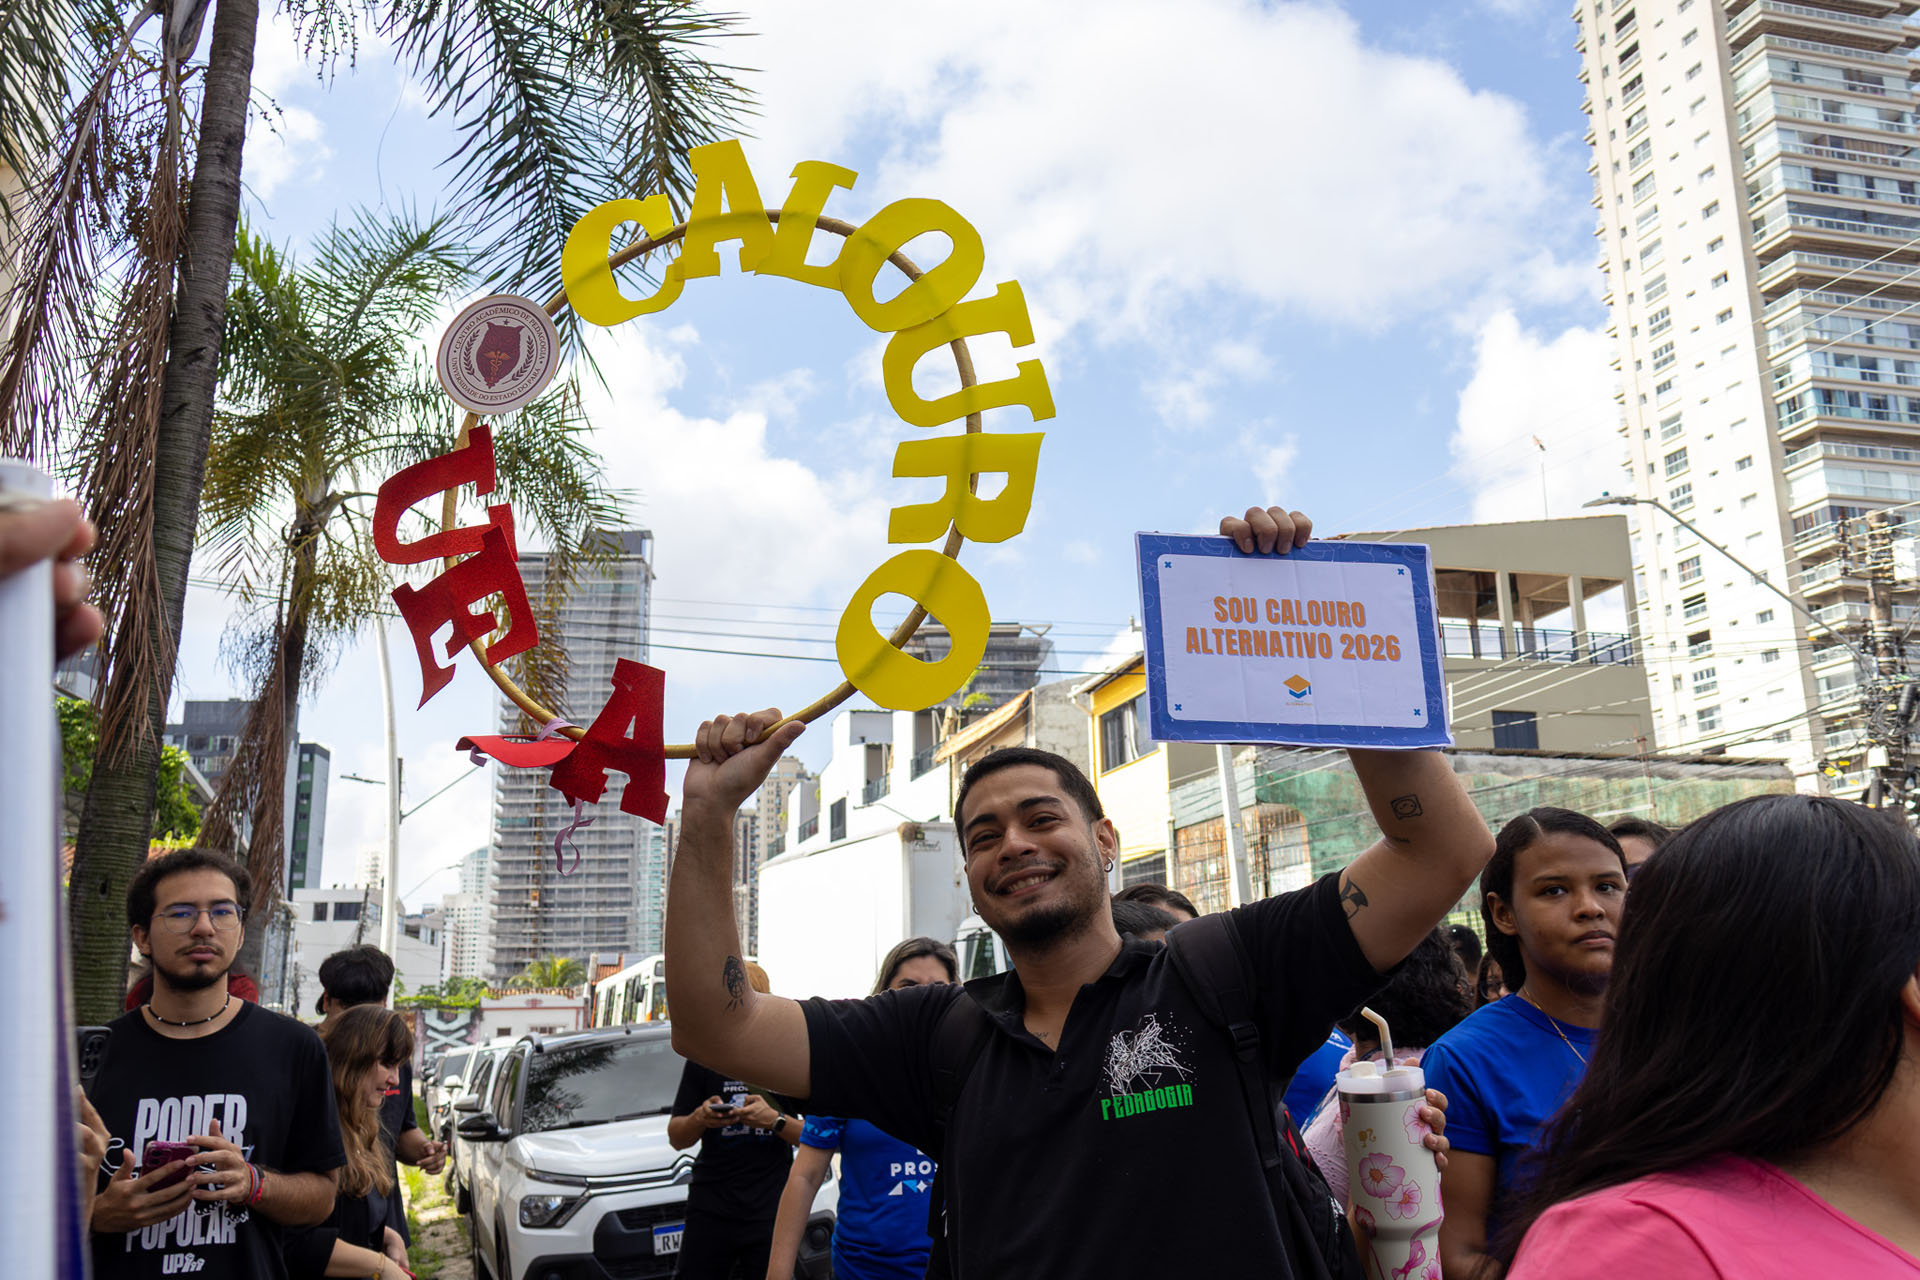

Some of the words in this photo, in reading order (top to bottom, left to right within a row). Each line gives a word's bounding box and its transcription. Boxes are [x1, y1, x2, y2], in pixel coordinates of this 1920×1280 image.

[455, 321, 475, 350] CENTRO
[519, 311, 530, 322] DE
[530, 320, 547, 361] PEDAGOGIA
[451, 357, 478, 399] UNIVERSIDADE
[478, 392, 490, 401] DO
[489, 389, 518, 401] ESTADO
[518, 383, 528, 393] DO
[561, 138, 1056, 711] CALOURO
[1213, 596, 1258, 623] SOU
[1266, 598, 1366, 628] CALOURO
[1186, 627, 1333, 659] ALTERNATIVO
[1340, 633, 1402, 662] 2026
[1100, 1084, 1193, 1121] PEDAGOGIA
[133, 1093, 247, 1168] PODER
